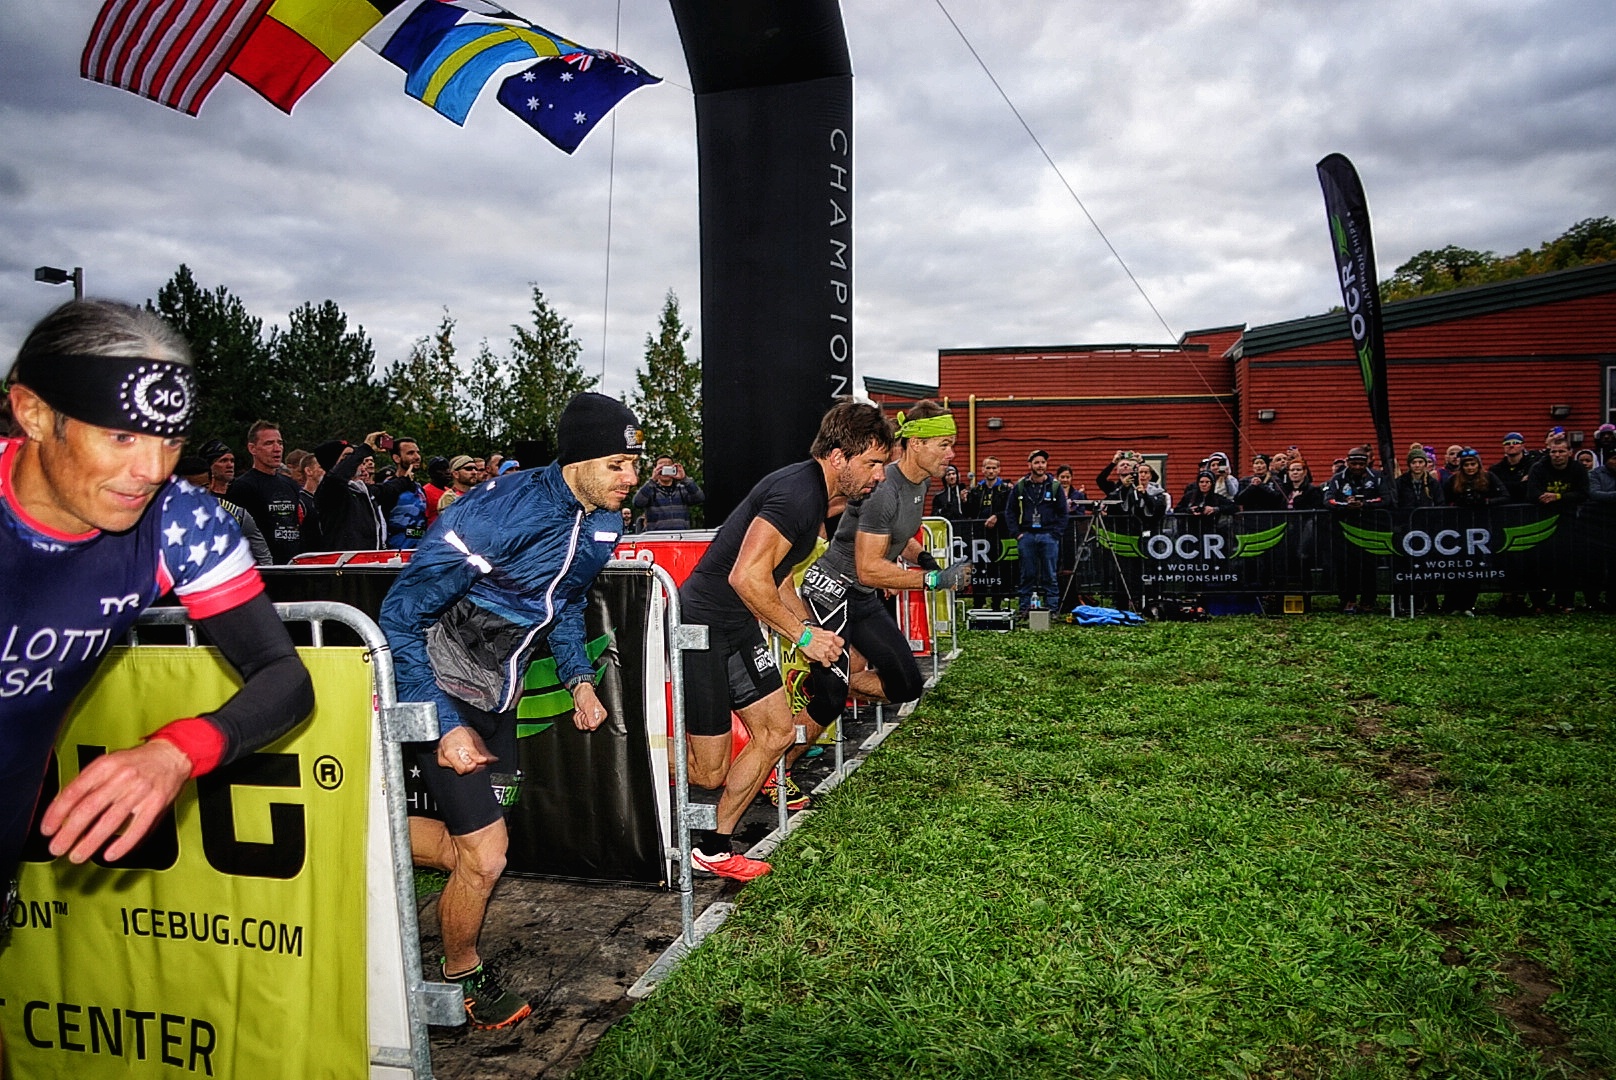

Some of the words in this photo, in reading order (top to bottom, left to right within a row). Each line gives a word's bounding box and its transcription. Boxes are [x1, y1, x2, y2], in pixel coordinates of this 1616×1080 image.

[1342, 259, 1366, 341] OCR
[1147, 534, 1226, 559] OCR
[1402, 528, 1492, 557] OCR
[1167, 563, 1210, 571] WORLD
[1396, 570, 1506, 581] CHAMPIONSHIPS
[1425, 560, 1473, 569] WORLD
[808, 570, 836, 593] 3175
[1141, 574, 1238, 582] CHAMPIONSHIPS
[100, 593, 140, 615] TYR
[0, 667, 54, 698] SA
[121, 907, 304, 957] ICEBUG.COM
[23, 1000, 217, 1077] CENTER
